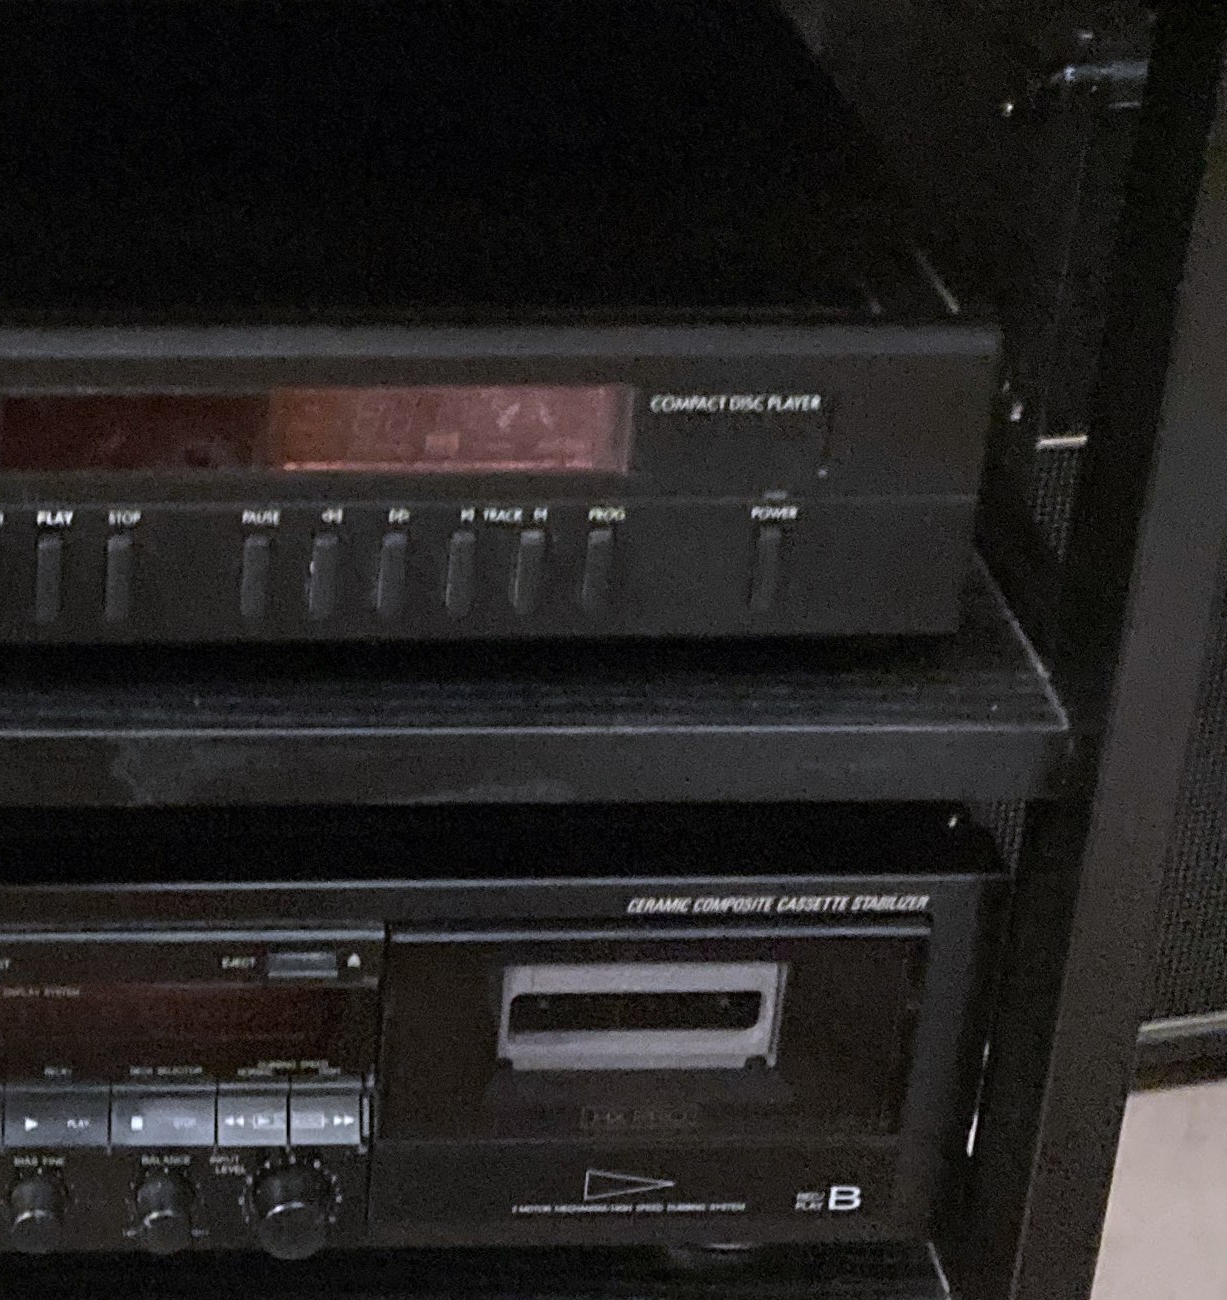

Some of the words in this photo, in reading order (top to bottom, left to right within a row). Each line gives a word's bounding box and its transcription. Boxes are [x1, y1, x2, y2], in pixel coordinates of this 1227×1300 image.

[650, 394, 727, 413] COMPACT
[729, 394, 766, 412] DISC
[767, 393, 821, 412] PLAYER
[36, 509, 73, 526] PLAY
[108, 509, 141, 526] STOP
[242, 509, 281, 526] PAUSE
[483, 506, 522, 523] TRACK
[750, 505, 799, 521] POWER
[627, 898, 692, 914] CERAMIC
[693, 897, 773, 913] COMPOSITE
[777, 896, 848, 912] CASSETTE
[851, 895, 930, 911] STABILIZER
[828, 1186, 861, 1211] B
